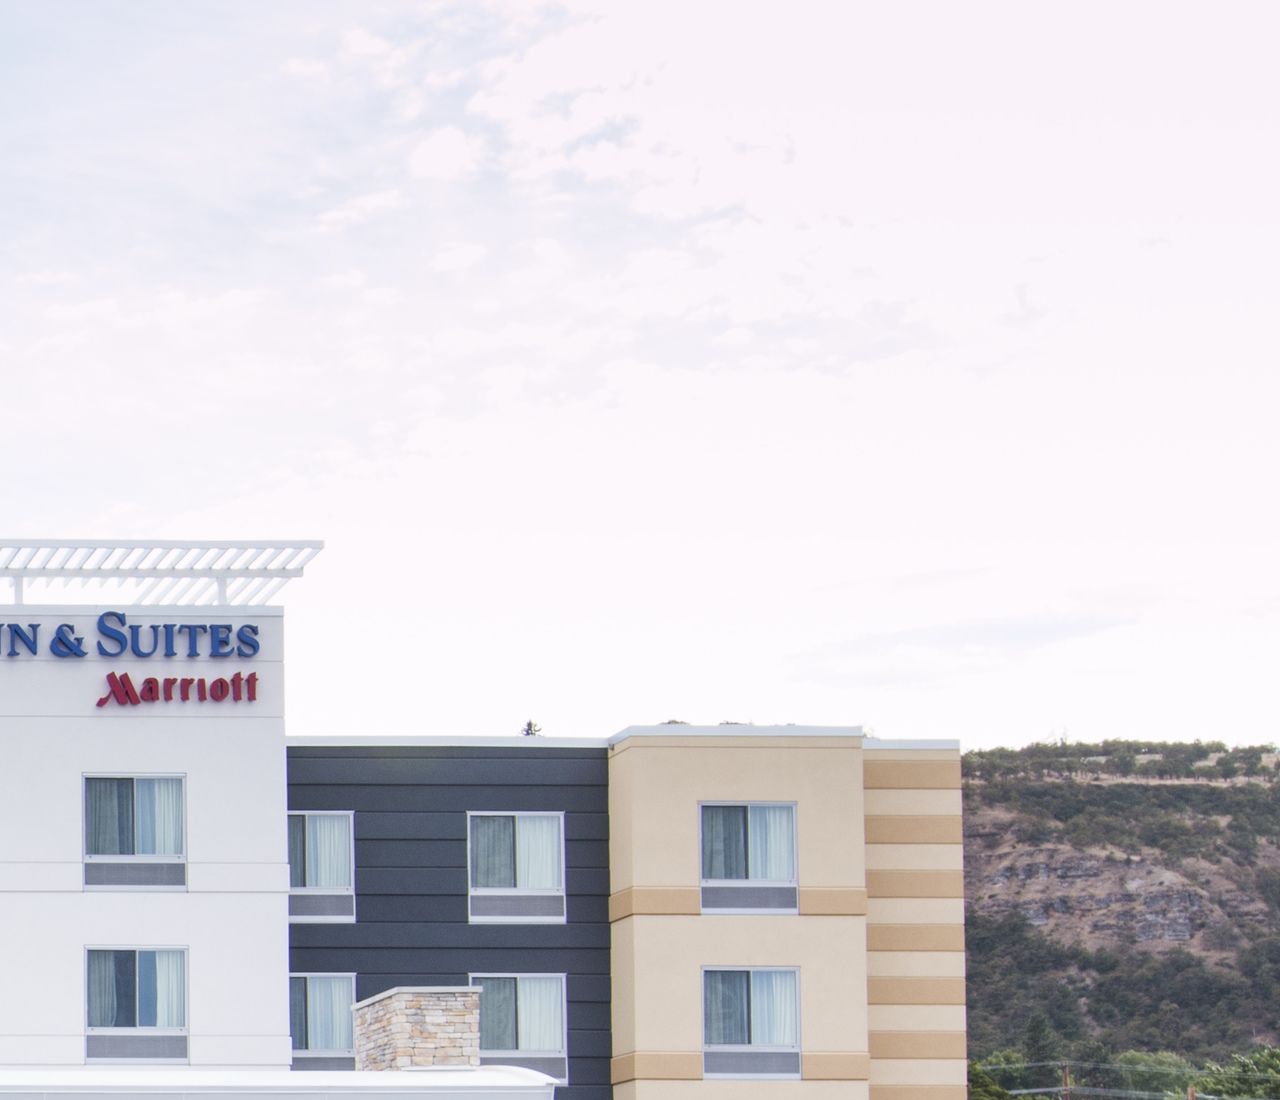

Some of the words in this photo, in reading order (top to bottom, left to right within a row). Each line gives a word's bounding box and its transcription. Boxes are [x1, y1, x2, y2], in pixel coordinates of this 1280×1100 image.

[49, 623, 89, 658] &
[96, 611, 261, 658] SUITES
[95, 671, 259, 708] Marriott
